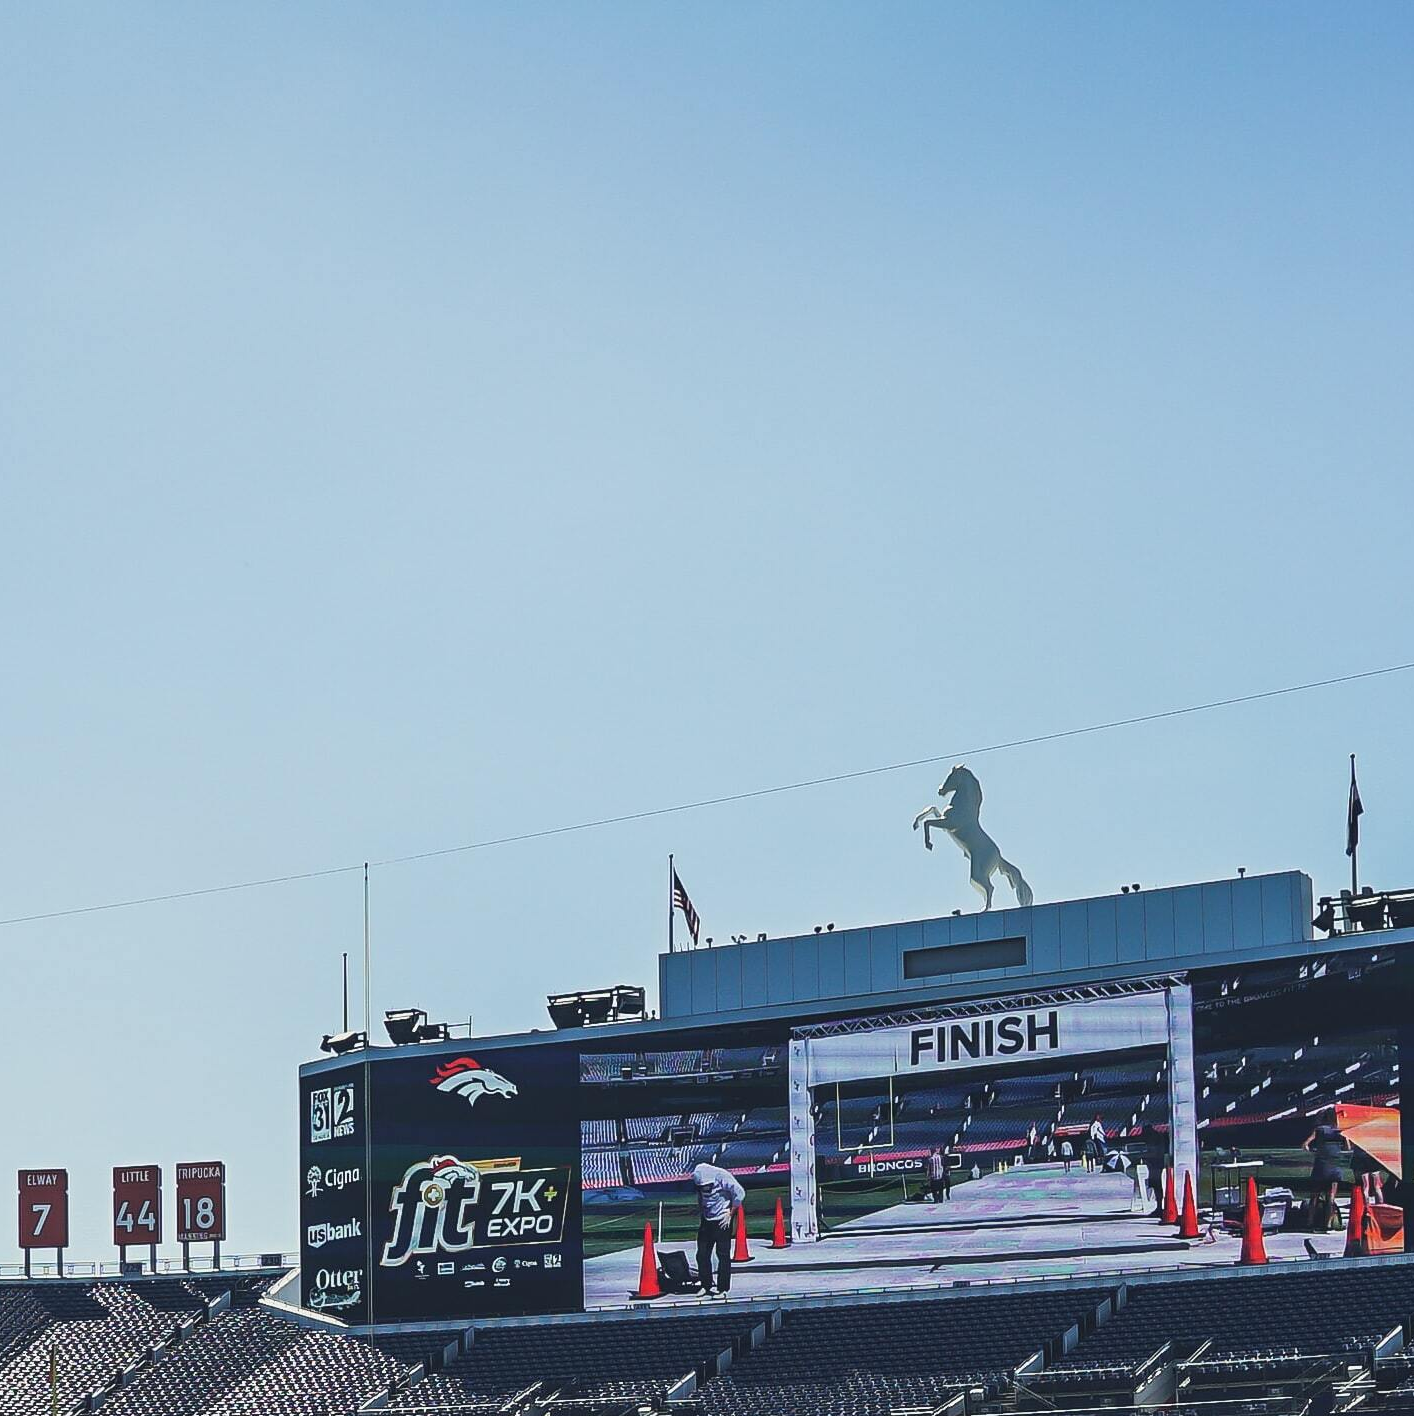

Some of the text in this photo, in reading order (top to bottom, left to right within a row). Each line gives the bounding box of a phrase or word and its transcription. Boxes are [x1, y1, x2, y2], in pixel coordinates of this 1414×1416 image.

[910, 1011, 1058, 1066] FINISH
[313, 1103, 329, 1131] 31
[121, 1170, 150, 1183] LITTLE
[179, 1166, 221, 1179] TRIPUCKA
[858, 1159, 923, 1173] BRONCOS
[27, 1174, 57, 1186] ELWAY
[325, 1168, 359, 1190] Cigna
[32, 1204, 52, 1235] 7
[116, 1200, 155, 1232] 44
[183, 1197, 214, 1230] 18
[487, 1215, 553, 1238] EXPO
[316, 1268, 363, 1289] Otter
